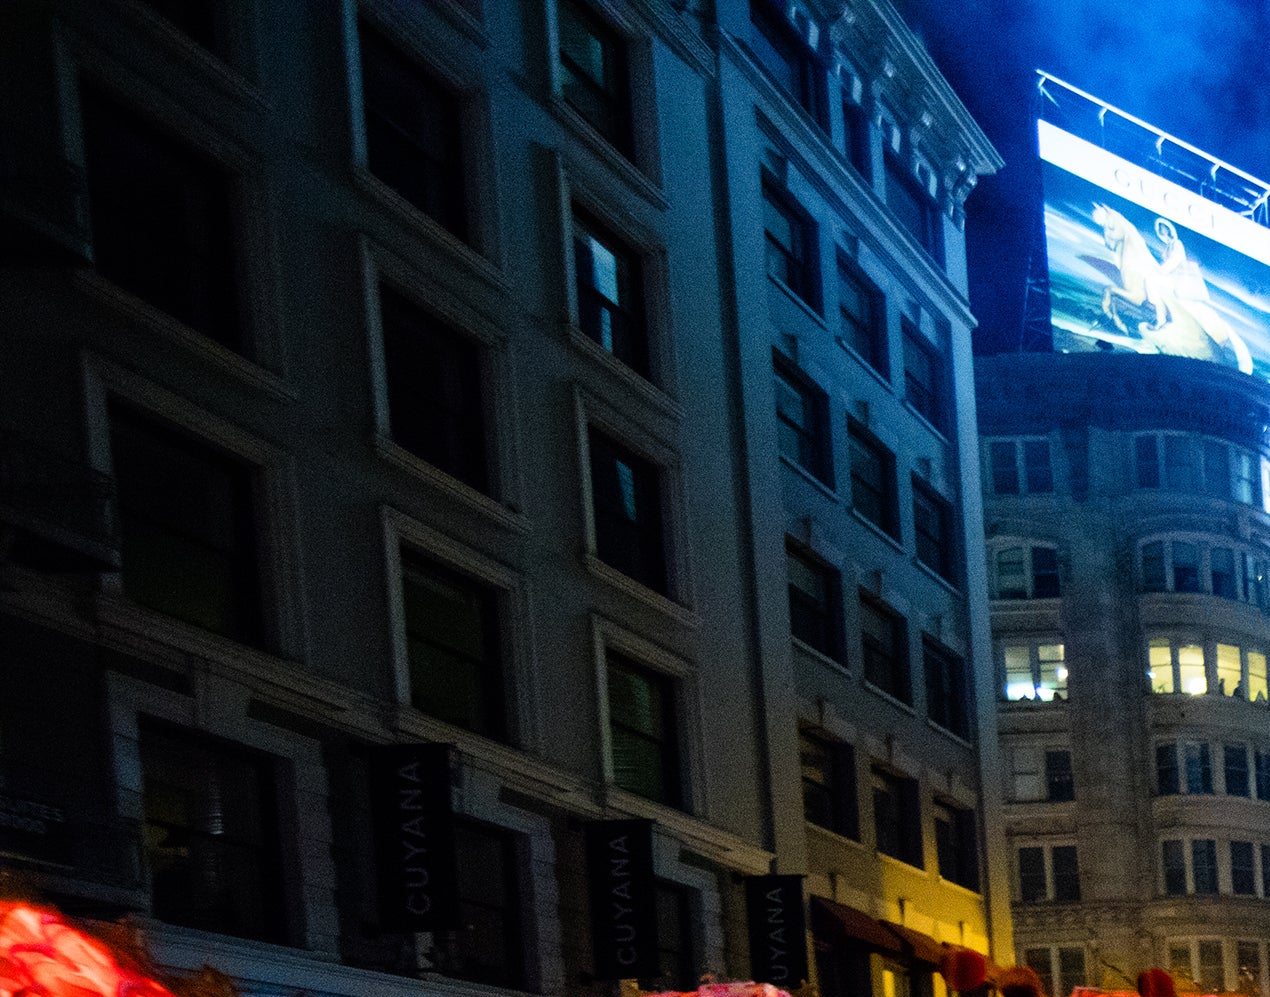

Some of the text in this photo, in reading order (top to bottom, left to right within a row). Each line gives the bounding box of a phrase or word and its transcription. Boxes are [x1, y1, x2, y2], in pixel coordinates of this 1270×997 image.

[1113, 168, 1215, 230] GUCCI
[398, 762, 432, 915] CUYANA
[609, 834, 637, 966] CUYANA
[766, 887, 790, 980] UYANA
